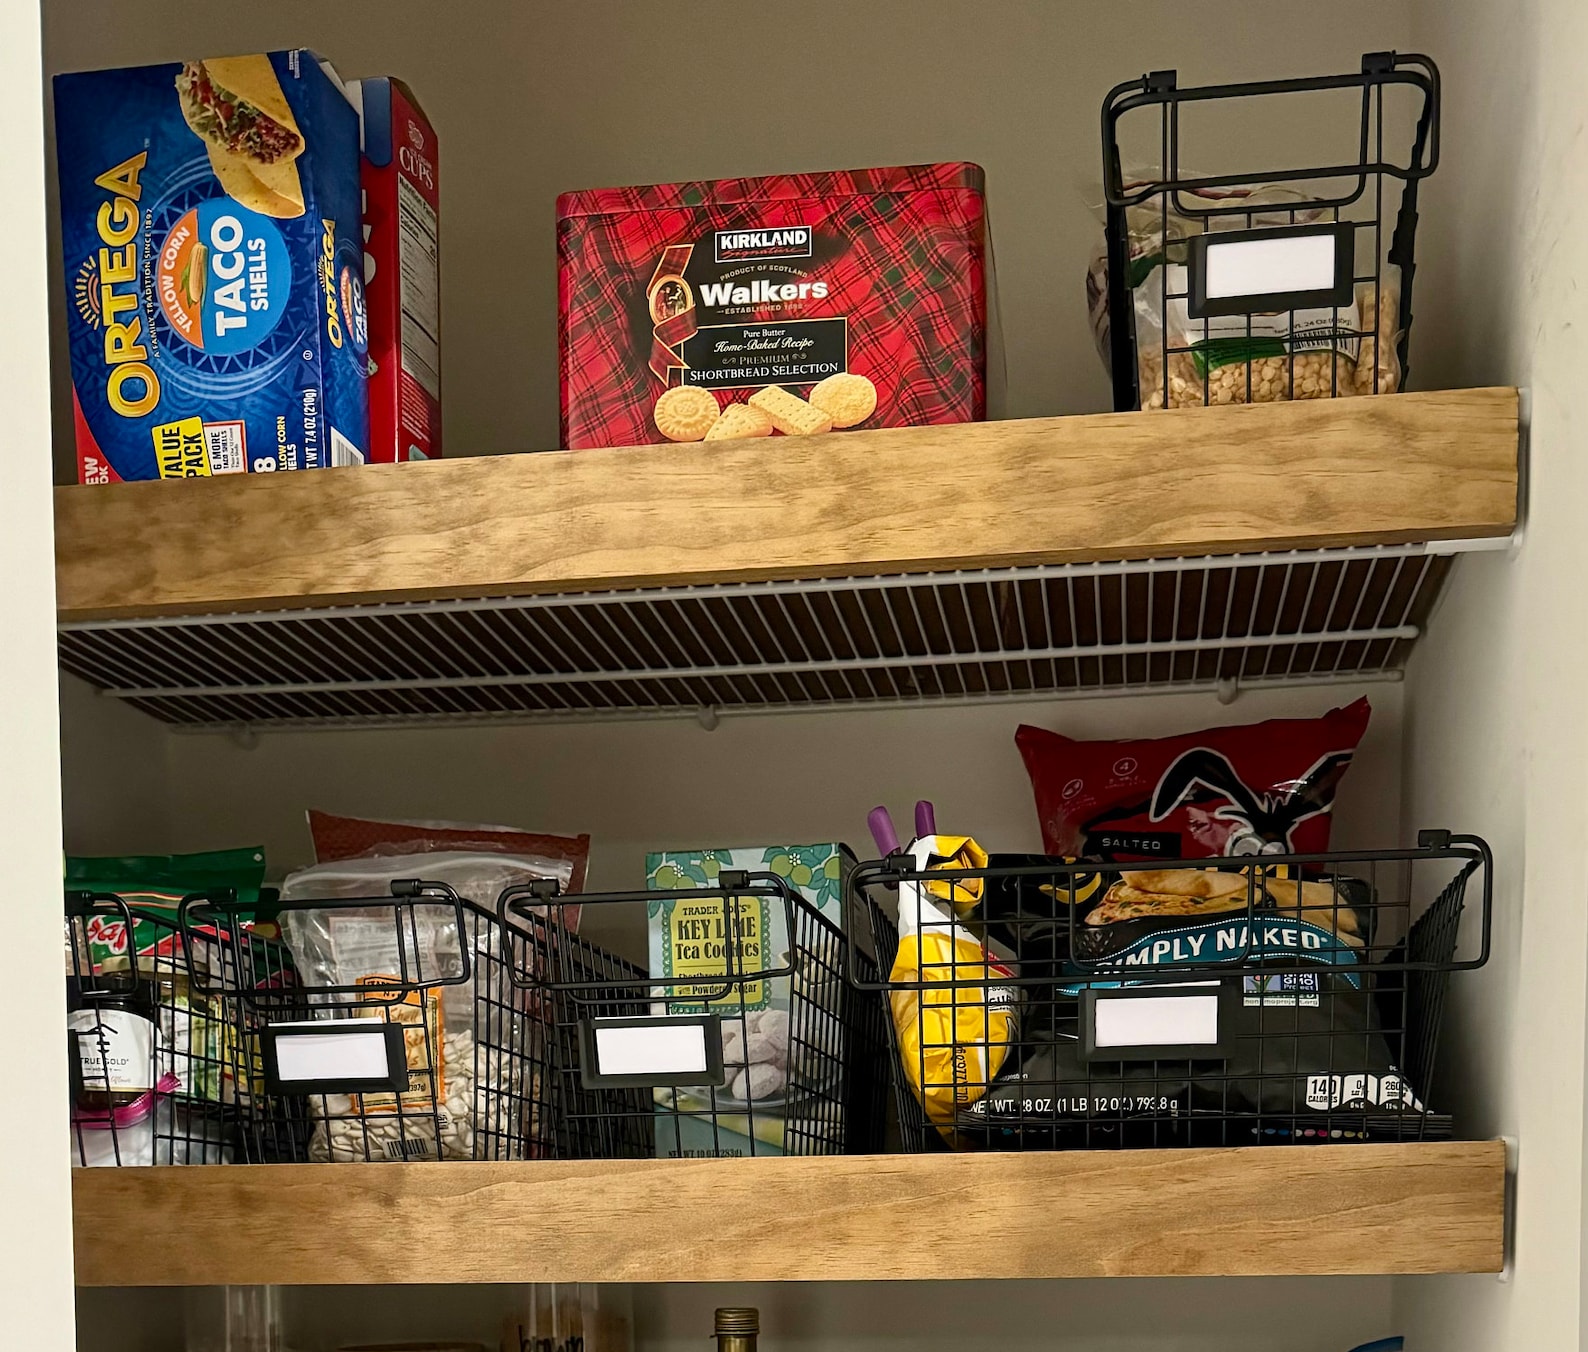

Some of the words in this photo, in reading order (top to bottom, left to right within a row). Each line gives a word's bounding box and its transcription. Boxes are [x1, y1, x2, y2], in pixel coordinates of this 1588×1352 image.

[400, 146, 434, 191] CUPS
[145, 208, 153, 230] 1897
[144, 231, 152, 260] SINCE
[163, 226, 191, 271] CORN
[721, 230, 808, 250] KIRKLAND
[210, 215, 247, 337] TACO
[250, 237, 268, 311] SHELLS
[322, 218, 343, 349] ORTEGA
[719, 265, 756, 281] PRODUCT
[757, 264, 768, 272] OF
[769, 264, 809, 279] SCOTLAND
[95, 151, 160, 417] ORTEGA
[144, 267, 153, 314] TRADITION
[699, 279, 829, 307] Walkers
[162, 276, 193, 333] YELLOW
[353, 277, 364, 345] TACO
[724, 304, 783, 315] ESTABLISHED
[148, 317, 160, 350] FAMILY
[713, 338, 781, 353] Home-Baked
[780, 336, 815, 351] Recipe
[743, 329, 761, 339] Pure
[762, 328, 786, 338] Butter
[739, 353, 790, 366] PREMIUM
[690, 367, 770, 382] SHORTBREAD
[771, 362, 839, 377] SELECTION
[302, 388, 317, 416] (210g)
[277, 416, 287, 442] CORN
[303, 416, 316, 429] OZ
[211, 431, 221, 460] MORE
[220, 430, 228, 452] SHELLS
[304, 431, 317, 445] 7.4
[213, 461, 222, 470] 6
[221, 452, 229, 469] TACO
[254, 456, 276, 473] 8
[306, 447, 318, 463] WT
[1101, 837, 1161, 851] SALTED
[682, 905, 719, 917] TRADER
[677, 918, 711, 941] KEY
[1217, 926, 1321, 950] NAKED
[675, 943, 700, 960] Tea
[1311, 1079, 1337, 1095] 140
[994, 1099, 1016, 1112] WT.
[1036, 1099, 1054, 1112] OZ.
[1057, 1098, 1067, 1114] (1
[1071, 1098, 1088, 1112] LB
[1094, 1097, 1108, 1111] 12
[1170, 1098, 1178, 1111] g
